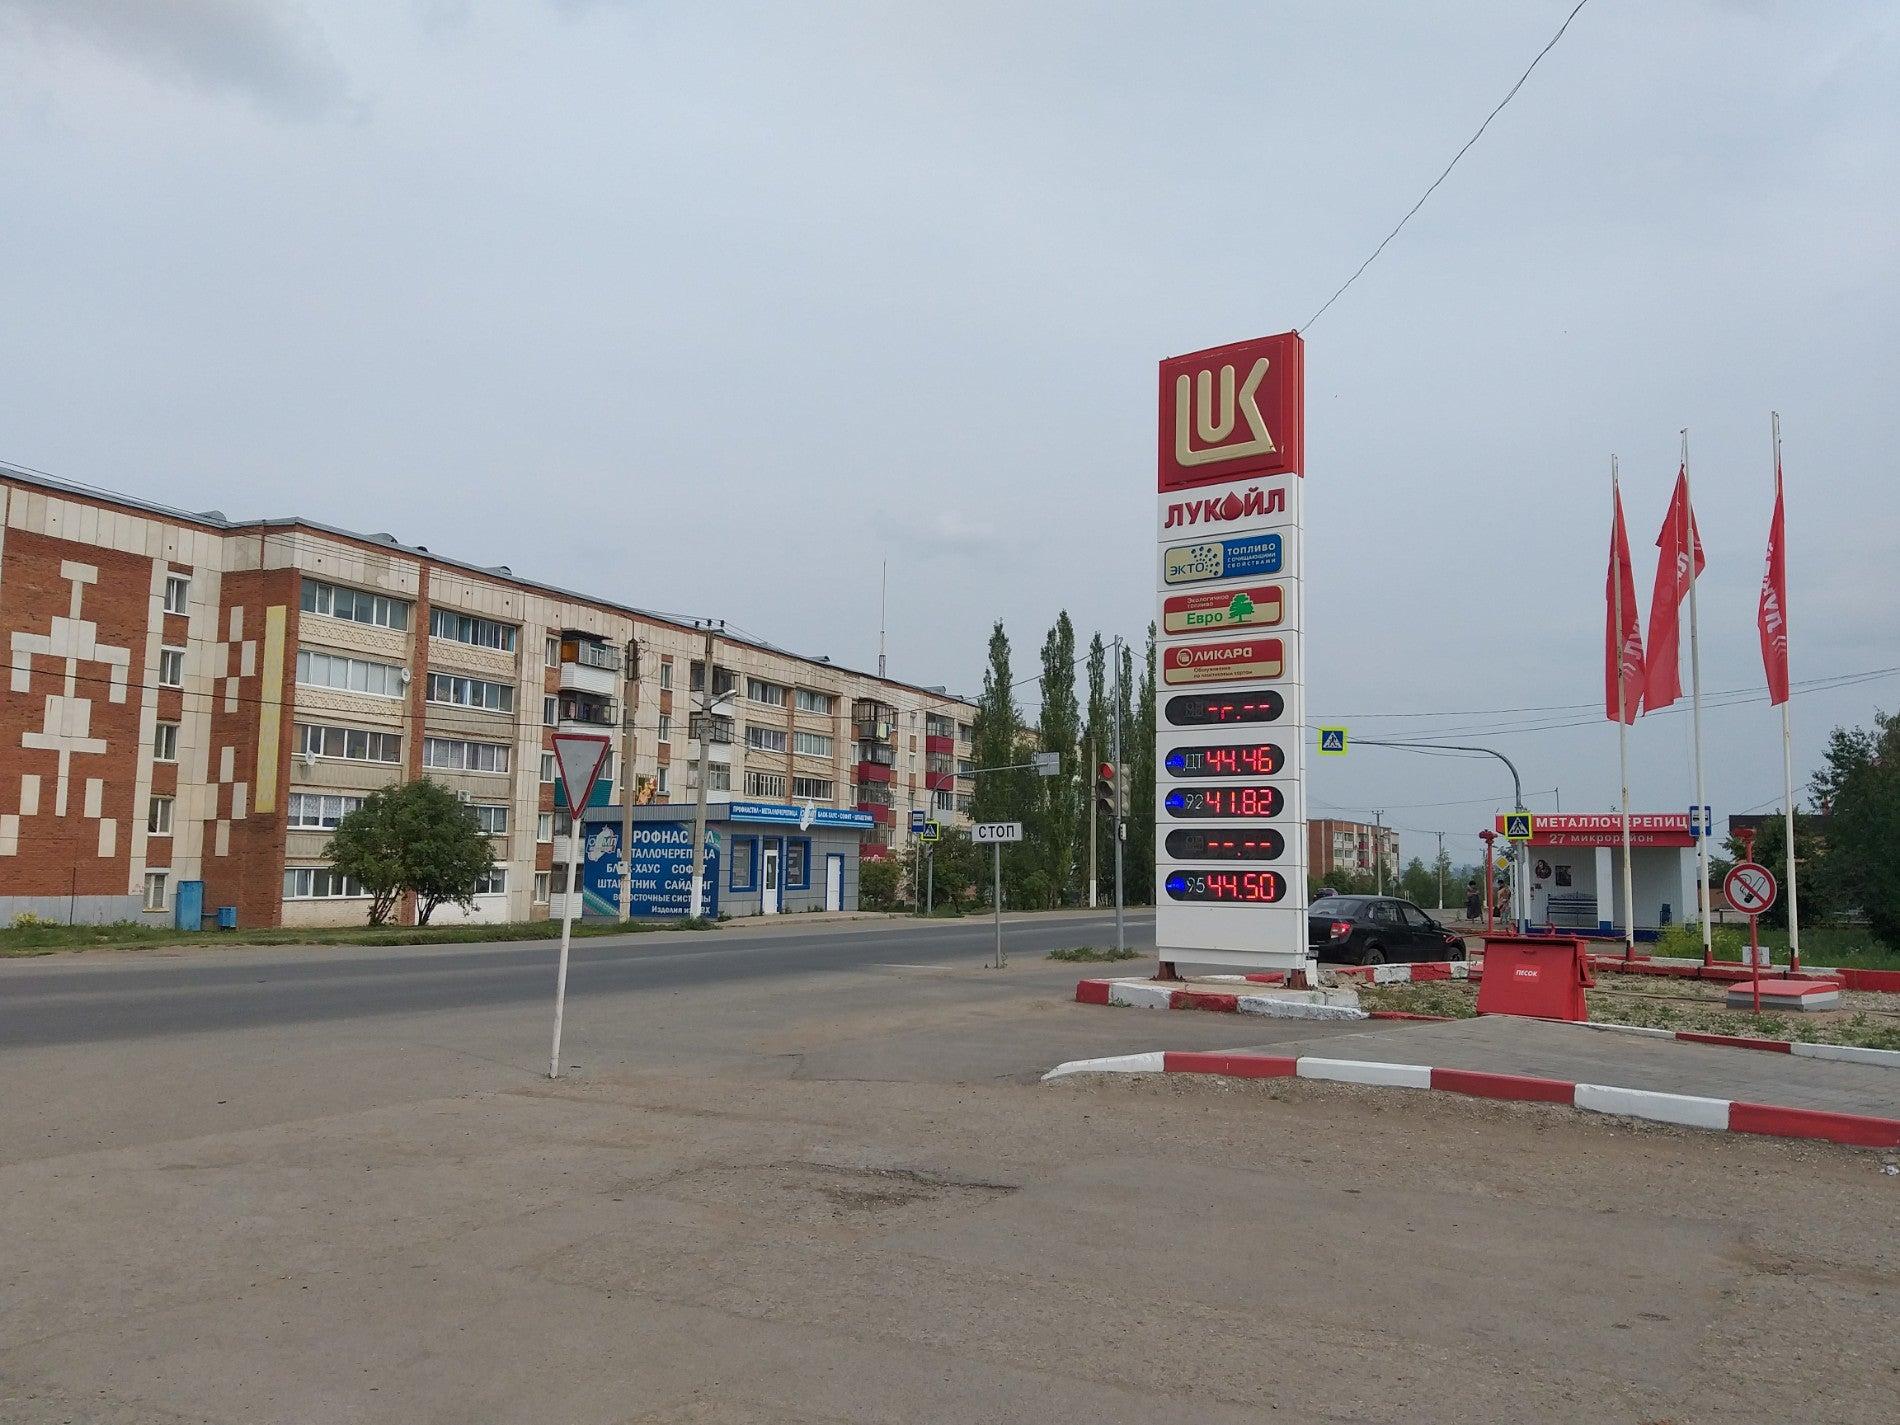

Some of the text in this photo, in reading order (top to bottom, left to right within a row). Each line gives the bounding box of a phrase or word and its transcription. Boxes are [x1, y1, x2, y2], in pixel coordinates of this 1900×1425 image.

[1164, 487, 1286, 528] ЛУКОЙЛ
[1228, 543, 1276, 555] ТОПЛИВО
[1170, 562, 1205, 576] ЭКТО
[1187, 612, 1223, 626] Евро
[1183, 754, 1204, 771] ДТ
[1206, 747, 1273, 773] 44.46
[1186, 794, 1204, 810] 92
[1206, 789, 1272, 815] 41.82
[633, 830, 715, 845] РОФНАСЛ
[978, 825, 1015, 838] СТОП
[1550, 834, 1566, 845] 27
[616, 848, 716, 860] МТАЛЛОЧЕРЕПЦА
[671, 864, 707, 874] СОФТ
[597, 877, 713, 891] ШТАТНИК САЙДНГ
[1186, 877, 1206, 893] 95
[1207, 874, 1275, 900] 44.50
[671, 895, 711, 903] СИСТЫ
